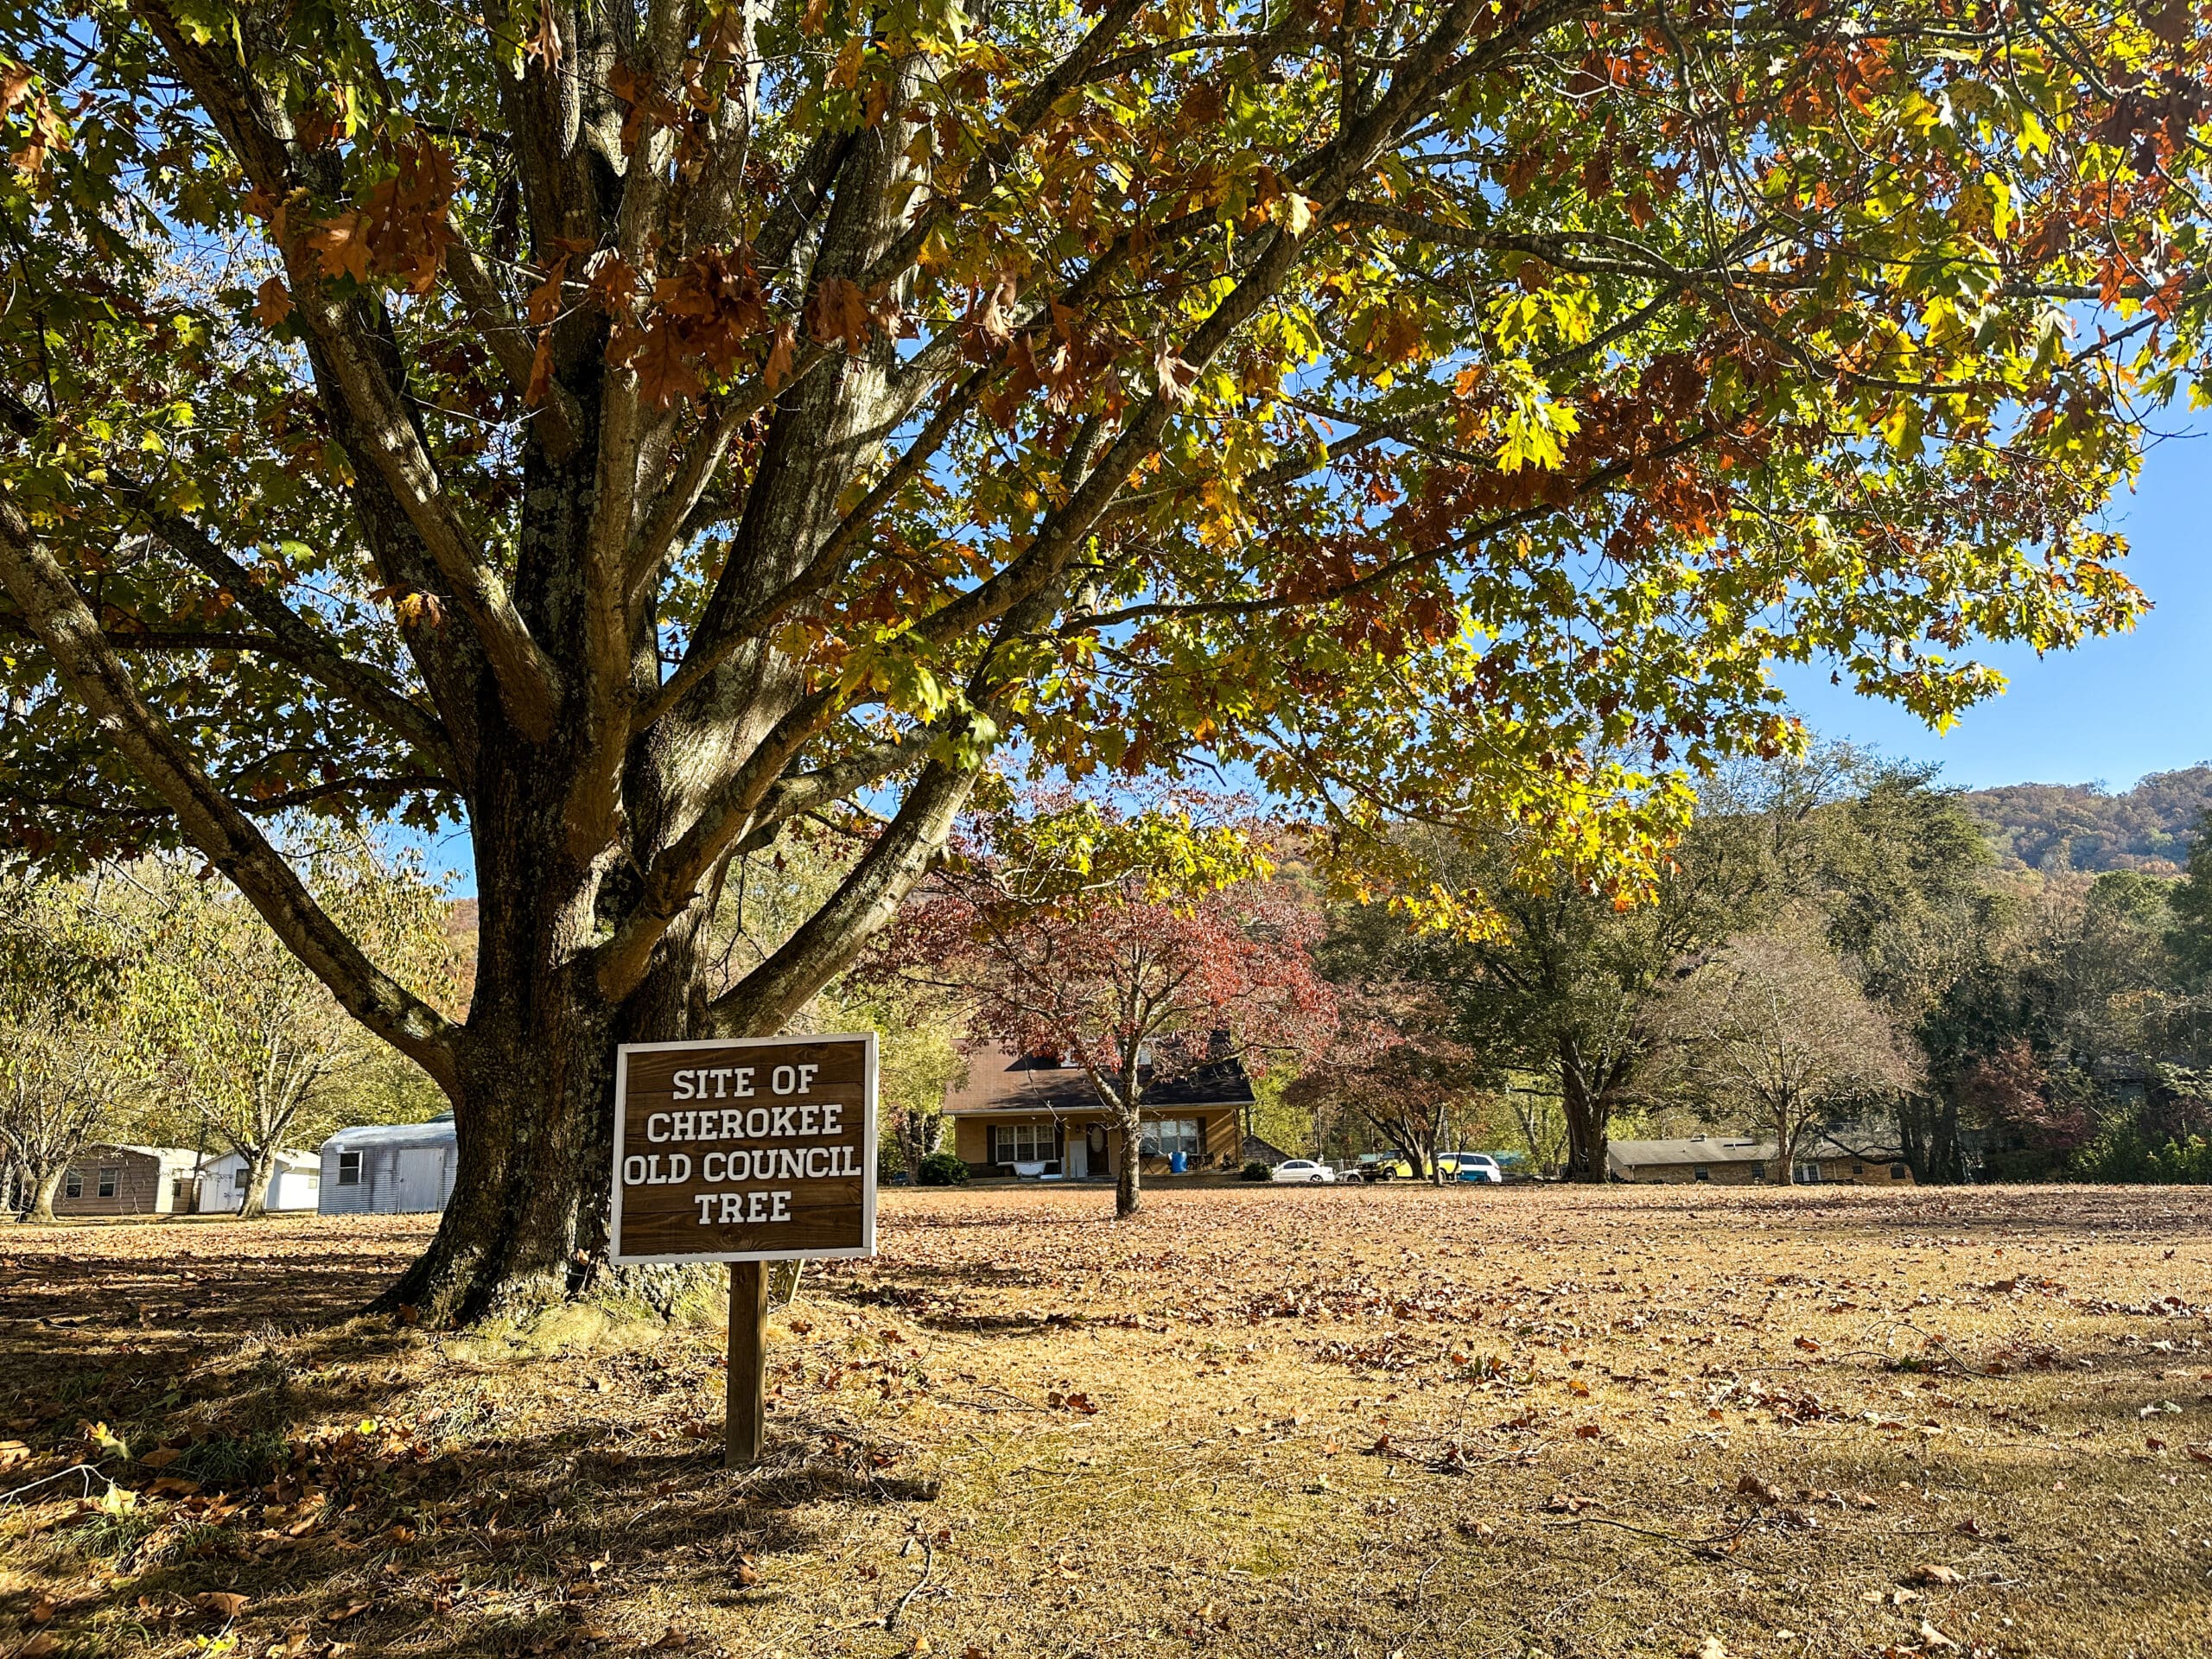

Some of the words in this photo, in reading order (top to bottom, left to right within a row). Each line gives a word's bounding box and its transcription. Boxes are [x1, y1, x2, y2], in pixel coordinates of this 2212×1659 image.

[673, 1068, 755, 1100] SITE
[772, 1064, 818, 1094] OF
[648, 1104, 842, 1142] CHEROKEE
[624, 1154, 691, 1185] OLD
[703, 1147, 861, 1181] COUNCIL
[695, 1191, 791, 1224] TREE
